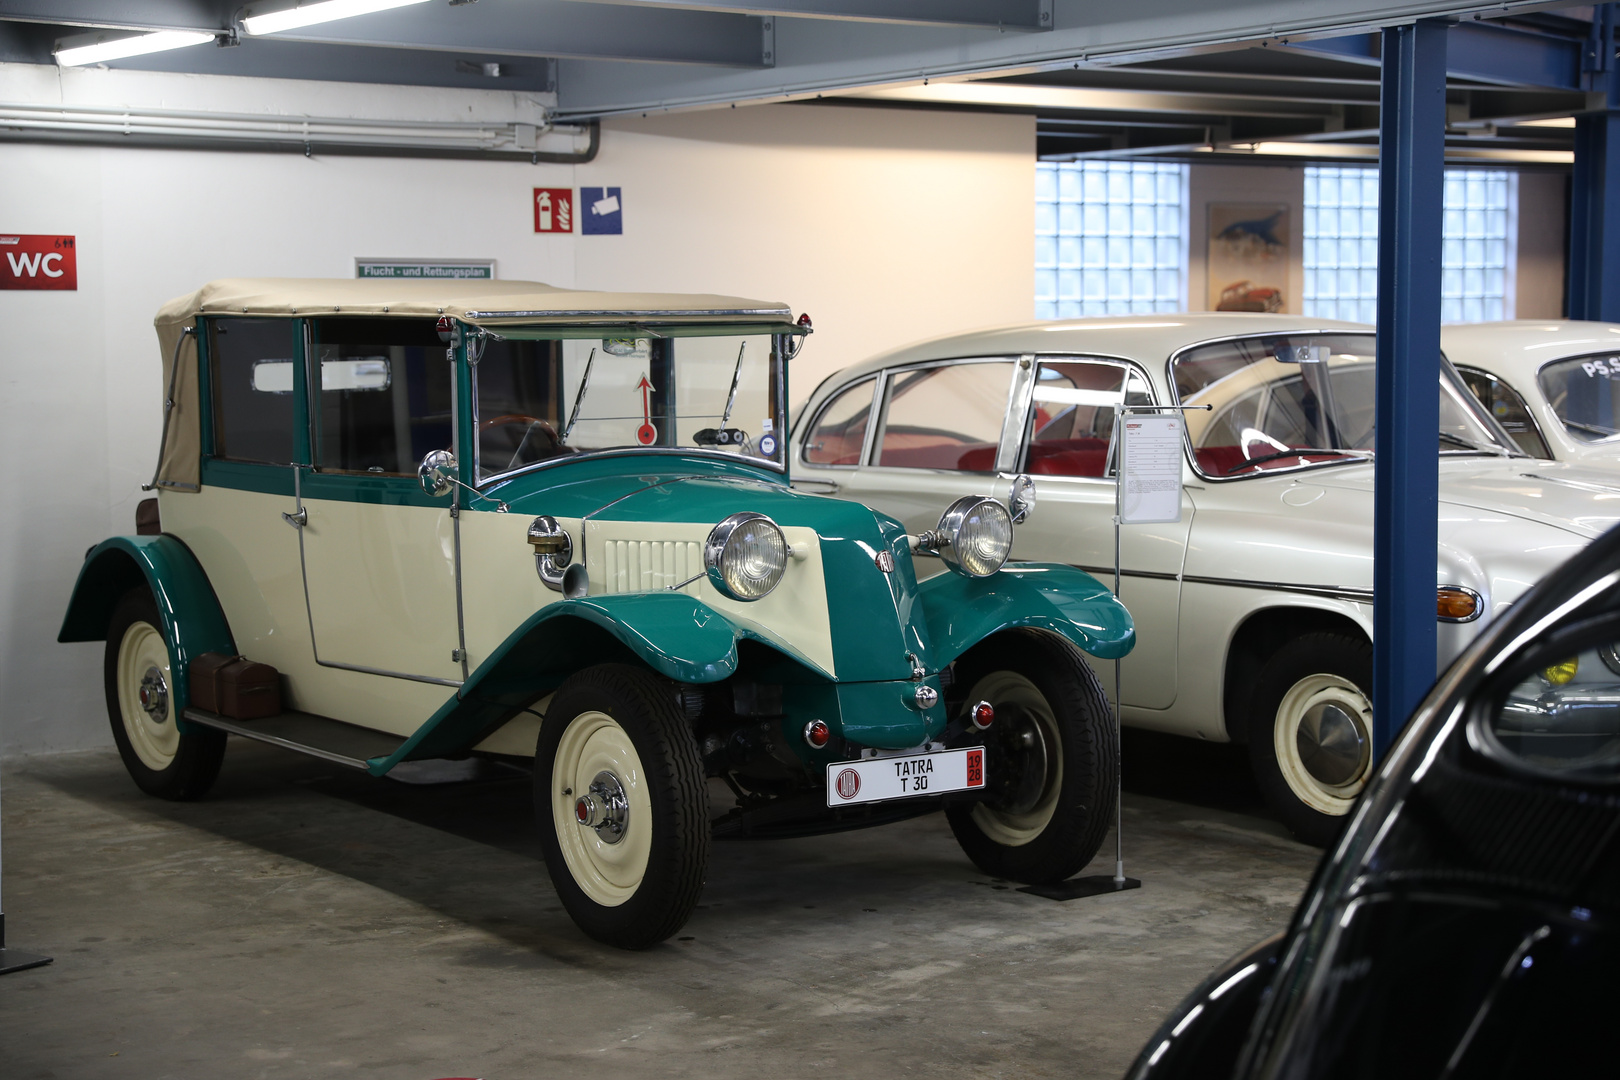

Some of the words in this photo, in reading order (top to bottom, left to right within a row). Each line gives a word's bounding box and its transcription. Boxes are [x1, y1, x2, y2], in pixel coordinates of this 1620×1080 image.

[6, 252, 64, 278] WC
[364, 266, 395, 276] Flucht
[403, 266, 421, 276] und
[423, 266, 485, 279] Rettungsplan
[1581, 356, 1620, 378] PS.S
[894, 758, 934, 777] TATRA
[968, 754, 981, 768] 19
[900, 777, 909, 792] T
[913, 775, 928, 791] 30
[968, 768, 981, 782] 28
